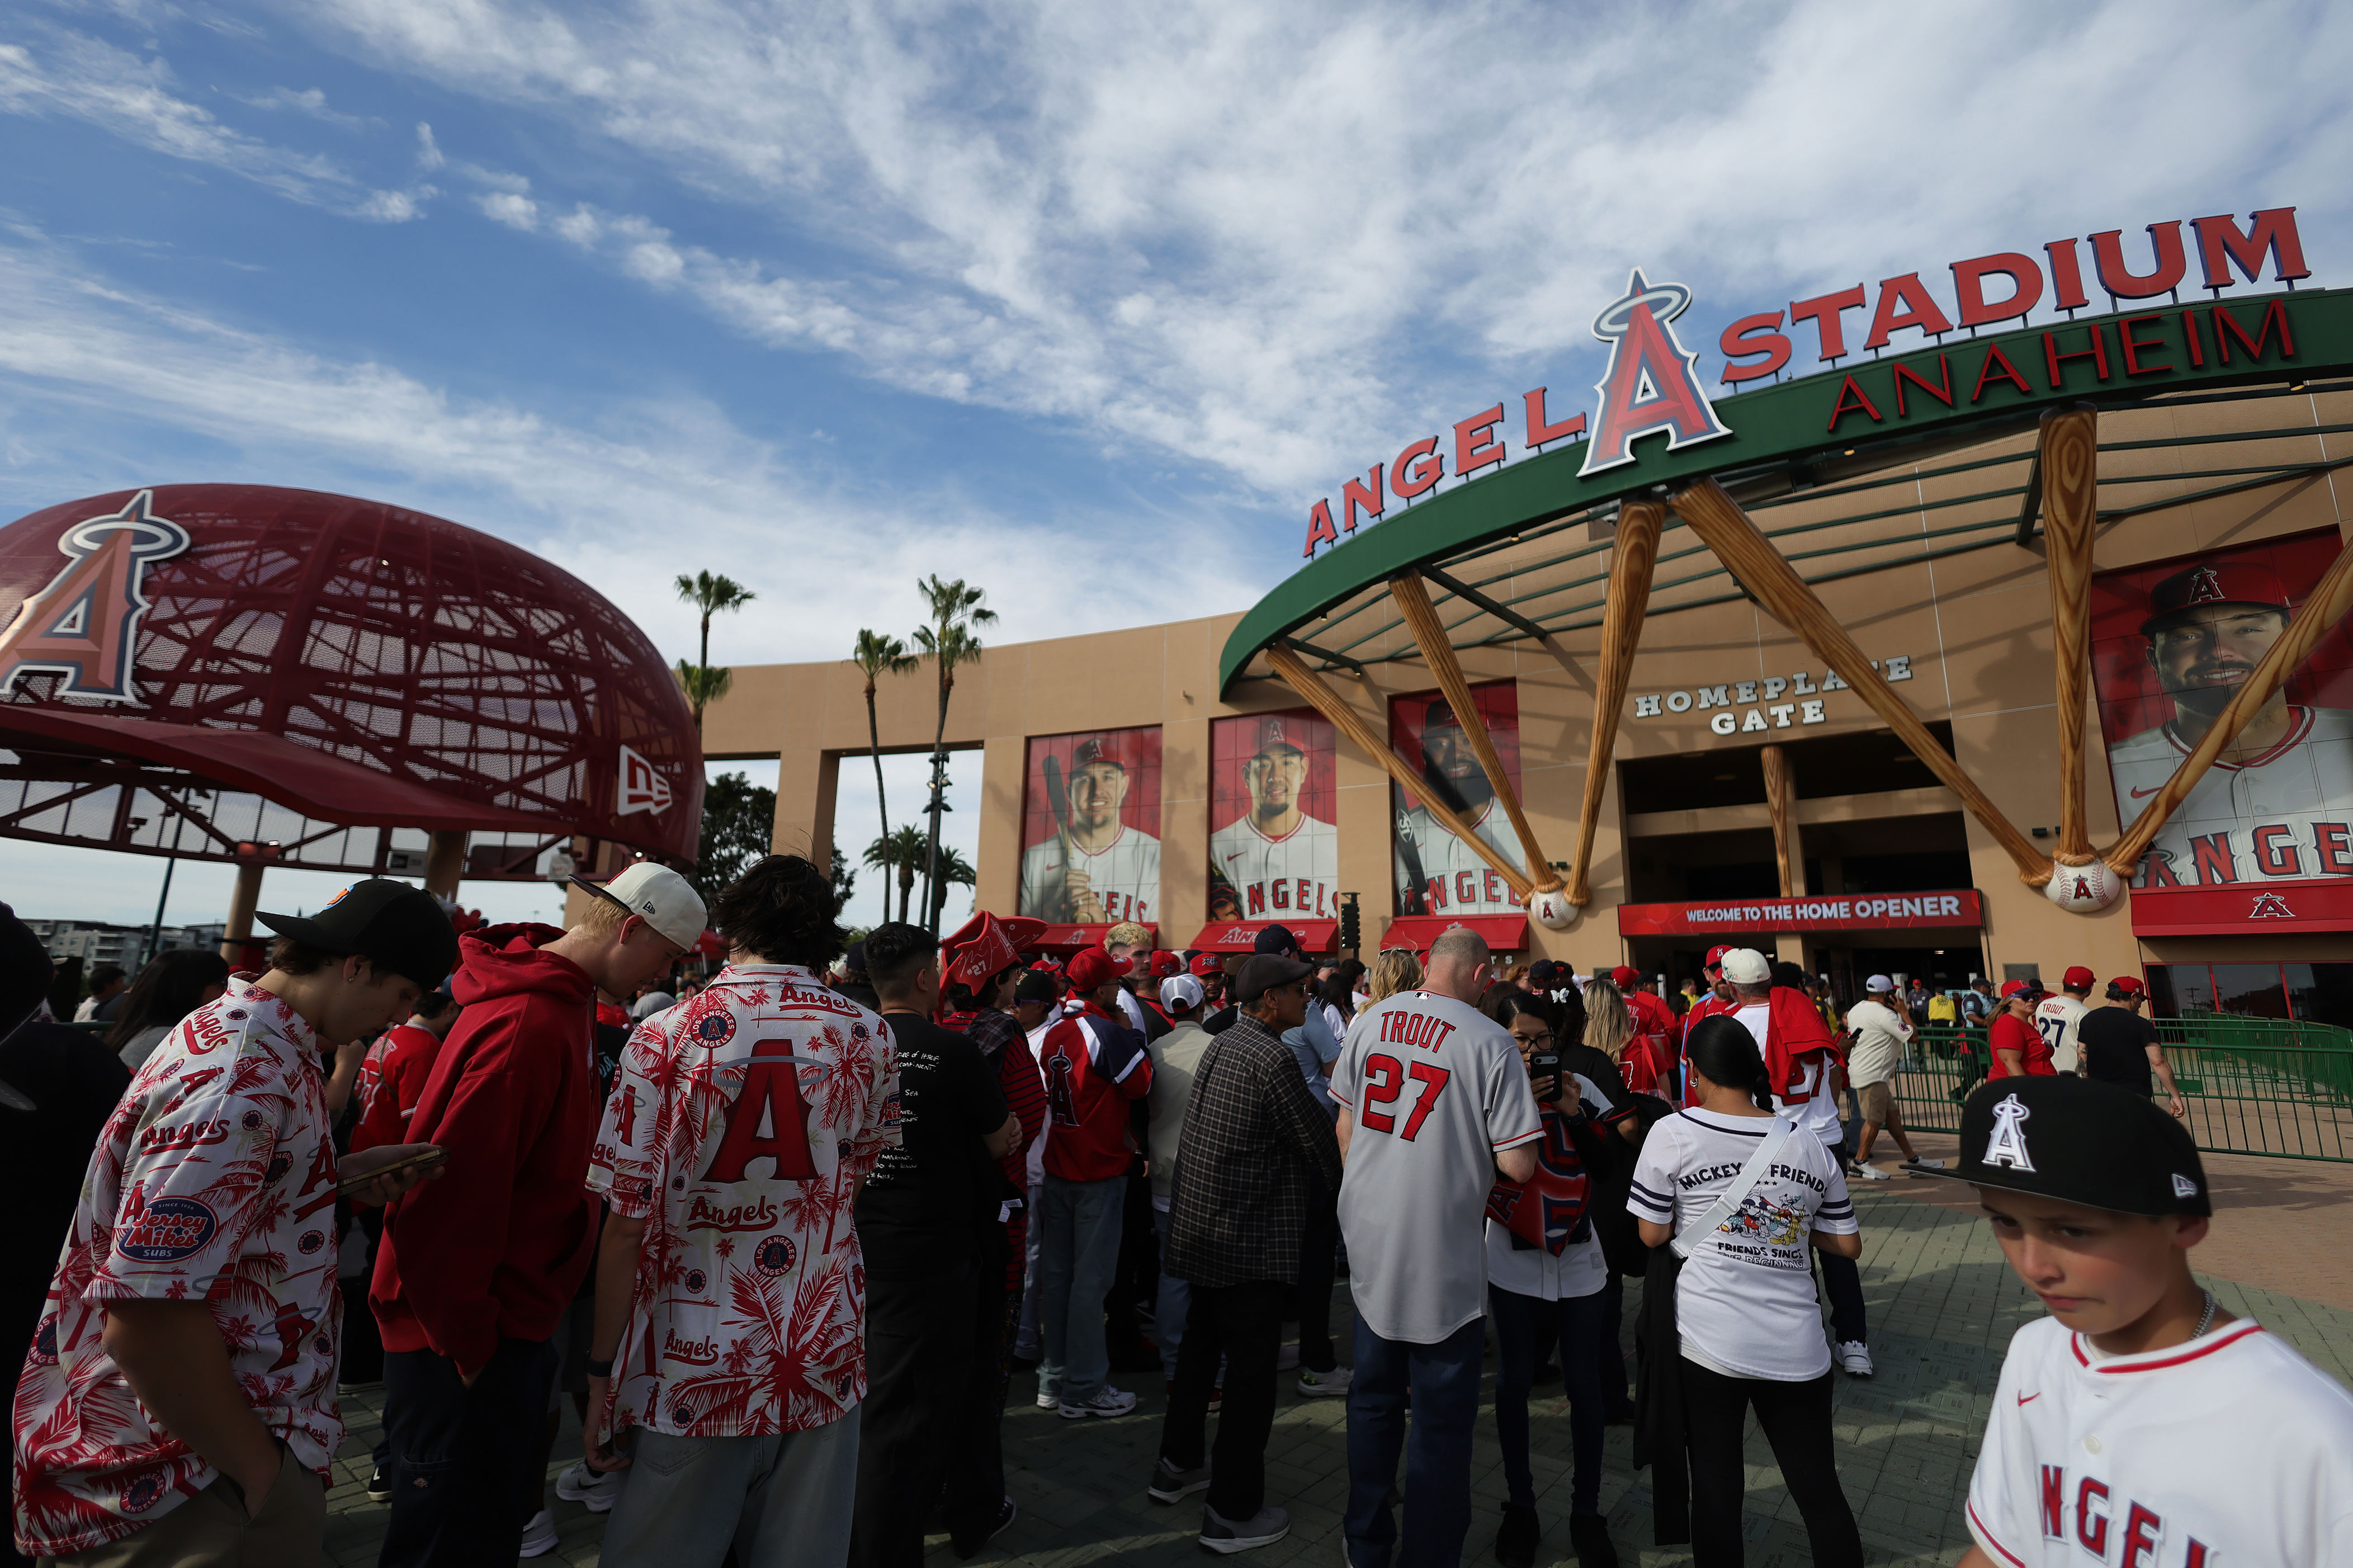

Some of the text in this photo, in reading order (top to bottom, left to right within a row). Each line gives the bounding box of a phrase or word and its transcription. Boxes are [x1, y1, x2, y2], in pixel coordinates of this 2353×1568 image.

[1827, 297, 2295, 432] ANAHEIM
[1302, 386, 1586, 558] ANGEL
[1719, 206, 2312, 385] STADIUM
[1635, 655, 1913, 718] HOMEPLAE
[1711, 699, 1826, 736] GATE
[1686, 895, 1962, 923] WELCOME TO THE HOME OPENER
[778, 983, 863, 1018] Angels
[2043, 1003, 2066, 1016] TROUT
[692, 1009, 735, 1035] LOS ANGELES
[1381, 1011, 1456, 1054] TROUT
[2039, 1016, 2066, 1047] 27
[697, 1033, 731, 1047] ANGELS
[699, 1039, 830, 1183] A
[1361, 1053, 1451, 1142] 27
[140, 1110, 230, 1158] Angels
[1679, 1162, 1742, 1191] MICKEY
[133, 1207, 209, 1234] Jersey
[687, 1196, 778, 1234] Angels
[124, 1227, 199, 1249] Mike's
[755, 1236, 795, 1260] LOS ANGELES
[1717, 1241, 1766, 1257] FRIENDS
[143, 1249, 173, 1258] SUBS
[758, 1263, 790, 1276] ANGELS
[34, 1317, 50, 1336] LOS
[663, 1328, 719, 1366] Angels
[121, 1473, 164, 1504] LOS ANGELES
[125, 1494, 158, 1514] ANGELS
